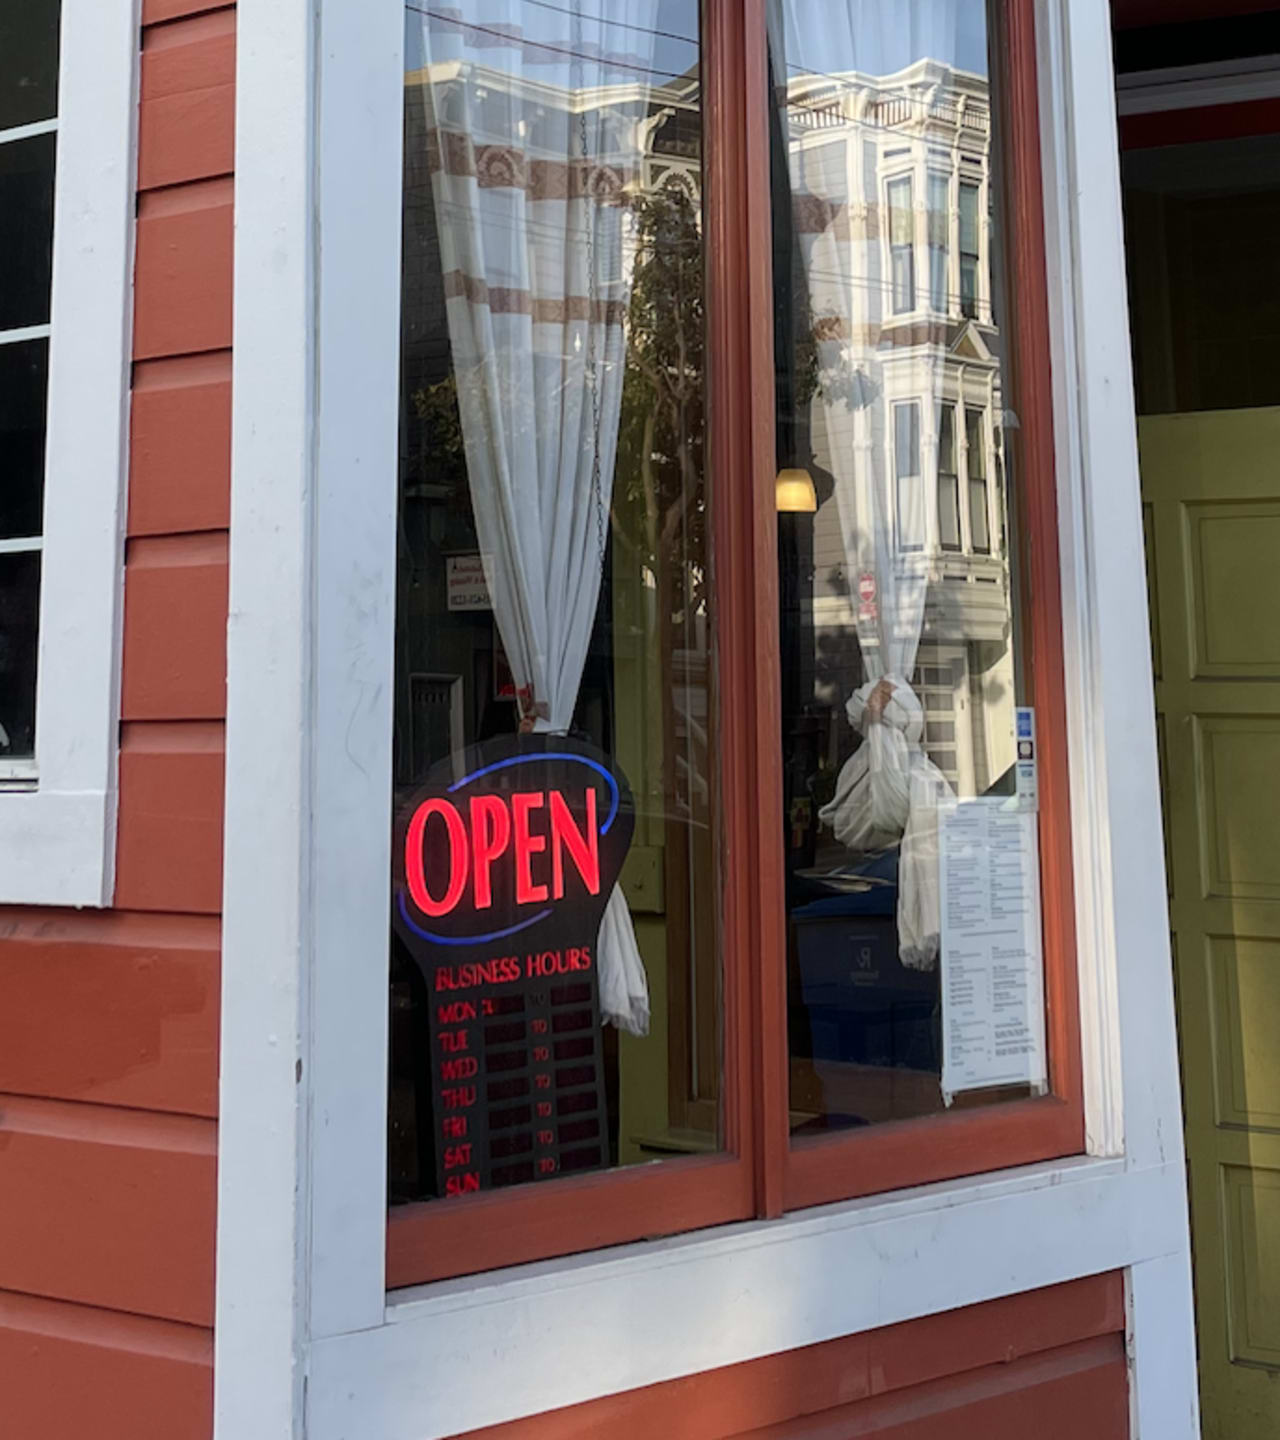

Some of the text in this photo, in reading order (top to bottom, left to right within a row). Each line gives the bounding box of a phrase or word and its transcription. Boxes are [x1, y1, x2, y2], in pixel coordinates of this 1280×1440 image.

[405, 788, 600, 917] OPEN
[435, 946, 592, 991] BUSINESS HOURS
[437, 1000, 477, 1025] MON
[438, 1029, 469, 1053] TUE
[440, 1057, 478, 1081] WED
[441, 1085, 477, 1109] THU
[442, 1115, 468, 1139] FRI
[443, 1143, 473, 1169] SAT
[445, 1172, 481, 1198] SUN
